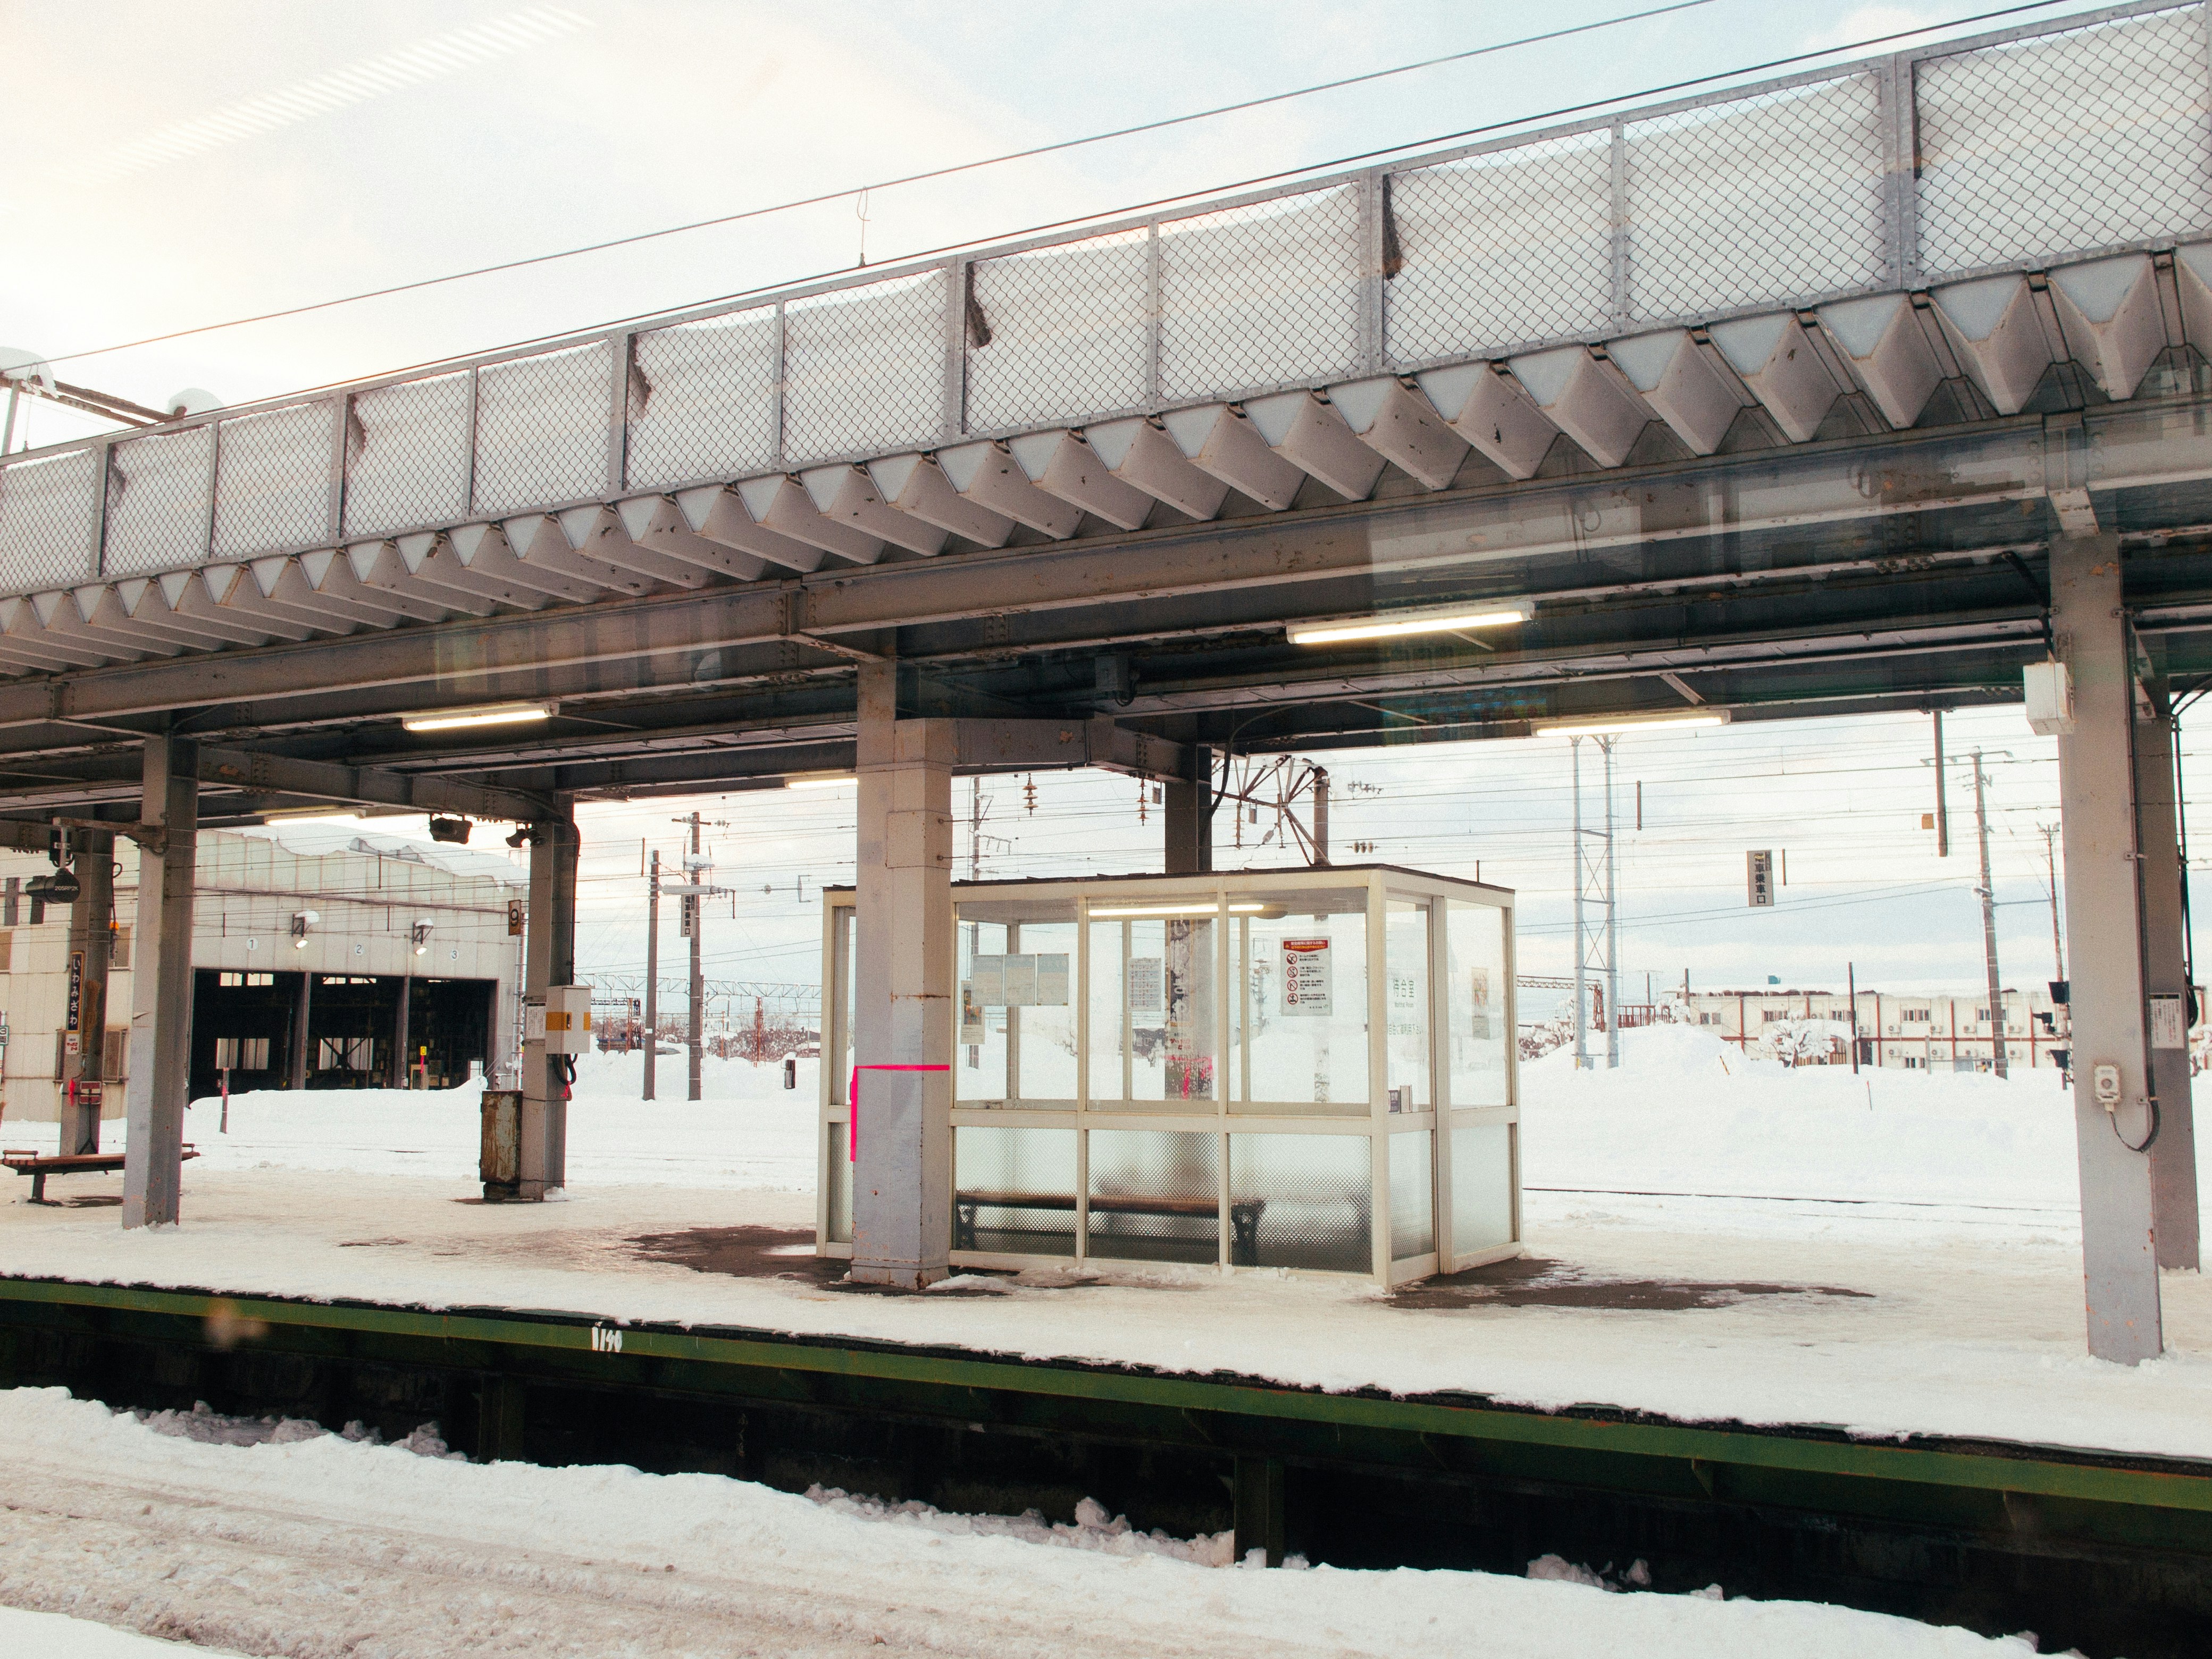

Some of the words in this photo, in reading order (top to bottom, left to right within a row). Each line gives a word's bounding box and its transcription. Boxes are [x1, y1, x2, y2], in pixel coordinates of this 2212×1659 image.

[510, 908, 519, 927] 9
[249, 939, 254, 949] 1
[356, 944, 362, 953] 2
[452, 950, 457, 959] 3
[69, 958, 80, 1026] いわみざわ
[1393, 979, 1414, 998] 待合室
